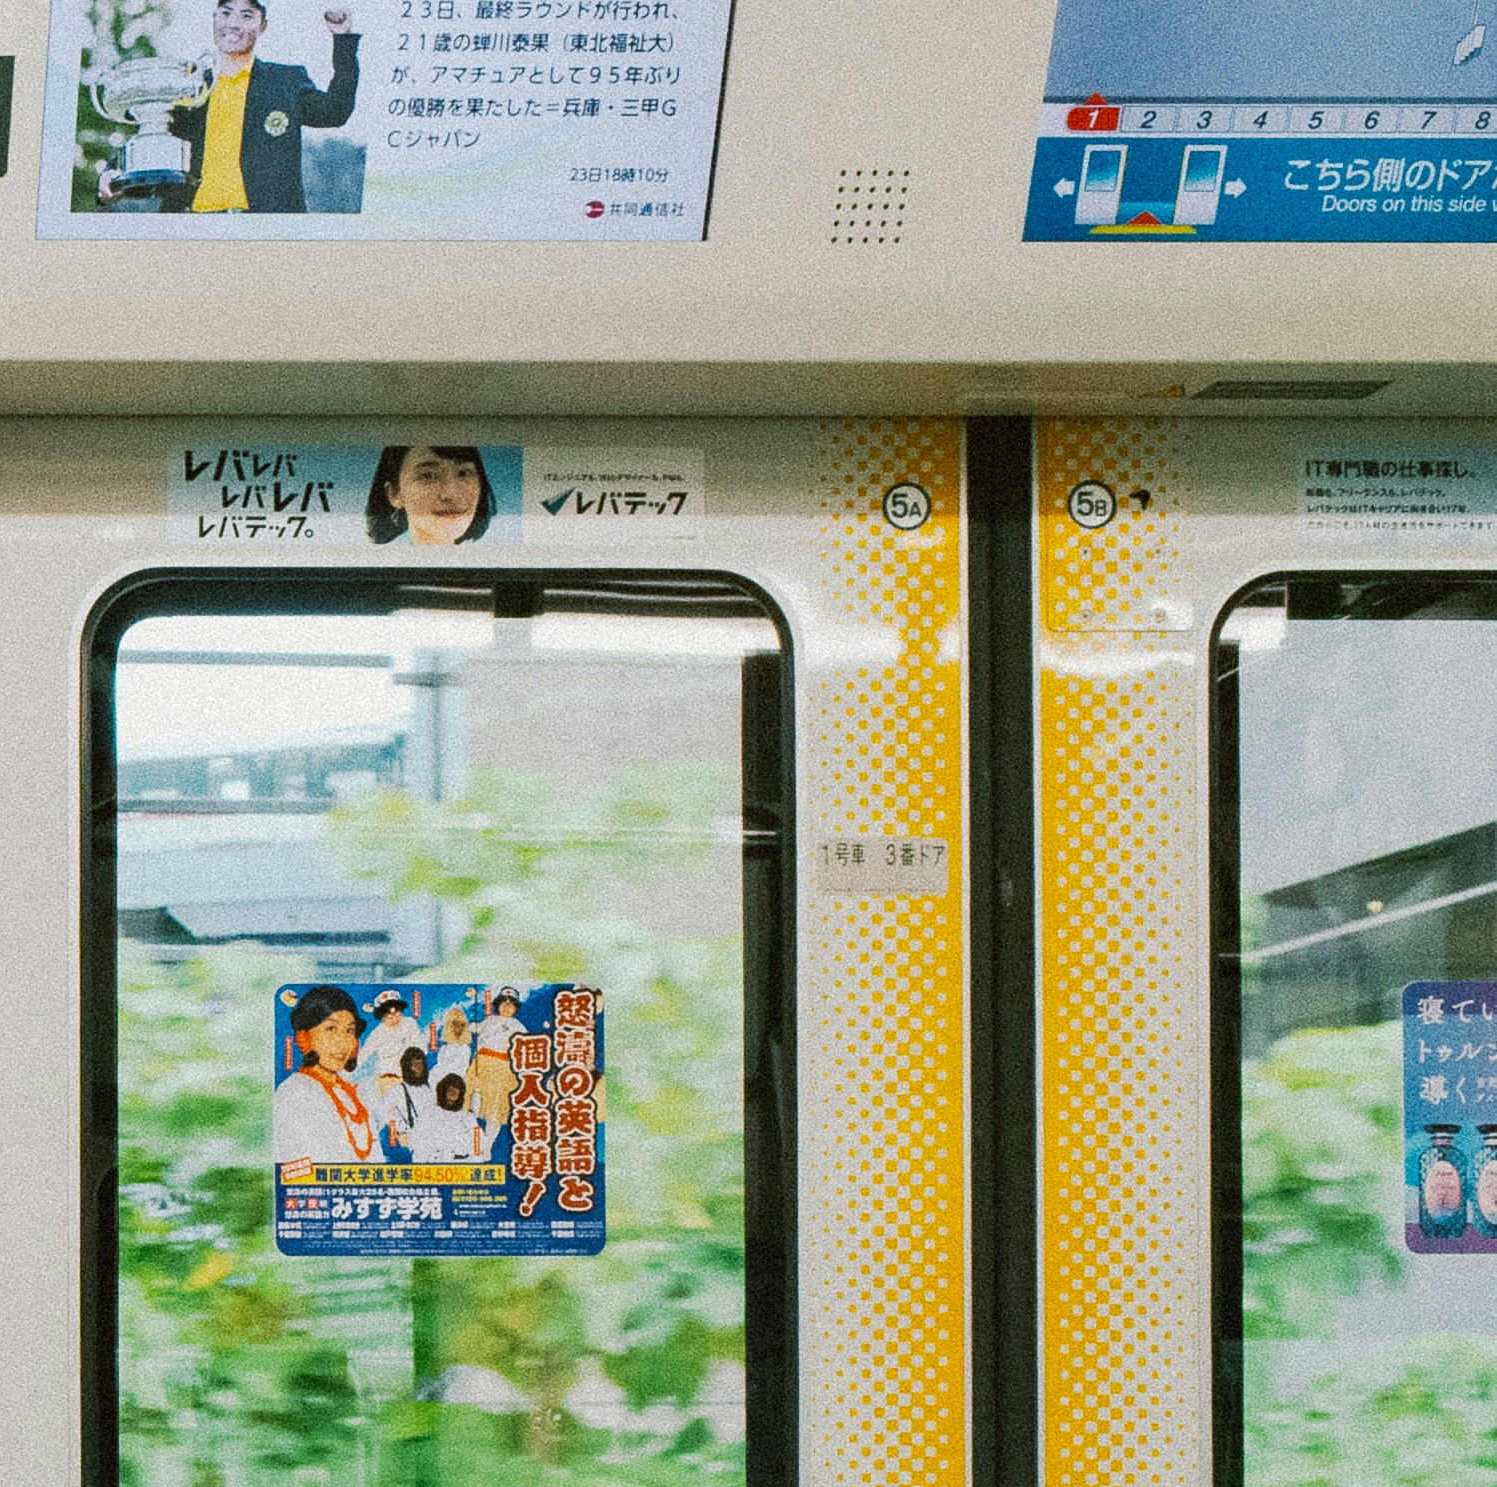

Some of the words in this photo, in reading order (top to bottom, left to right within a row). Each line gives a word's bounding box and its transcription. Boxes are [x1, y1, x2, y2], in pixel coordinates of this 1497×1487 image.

[1087, 110, 1100, 129] 1
[1139, 111, 1157, 130] 2
[1196, 111, 1213, 130] 3
[1253, 111, 1268, 130] 4
[1308, 111, 1324, 130] 5
[1364, 111, 1380, 130] 6
[1421, 111, 1438, 130] 7
[1474, 111, 1491, 130] 8
[570, 168, 669, 183] 23日18時10分
[1284, 159, 1497, 192] こちら側のドア
[609, 201, 685, 217] 共同通信社
[1323, 195, 1377, 213] Doors
[1382, 199, 1406, 213] on
[1411, 195, 1443, 213] this
[1448, 195, 1487, 213] side
[575, 490, 689, 516] レバテック
[890, 493, 923, 518] 5A
[1076, 492, 1108, 517] 5B
[198, 514, 315, 539] レバテック。
[821, 843, 866, 867] 1号車
[885, 843, 946, 867] 3番ドア
[331, 1197, 443, 1220] みすず学苑
